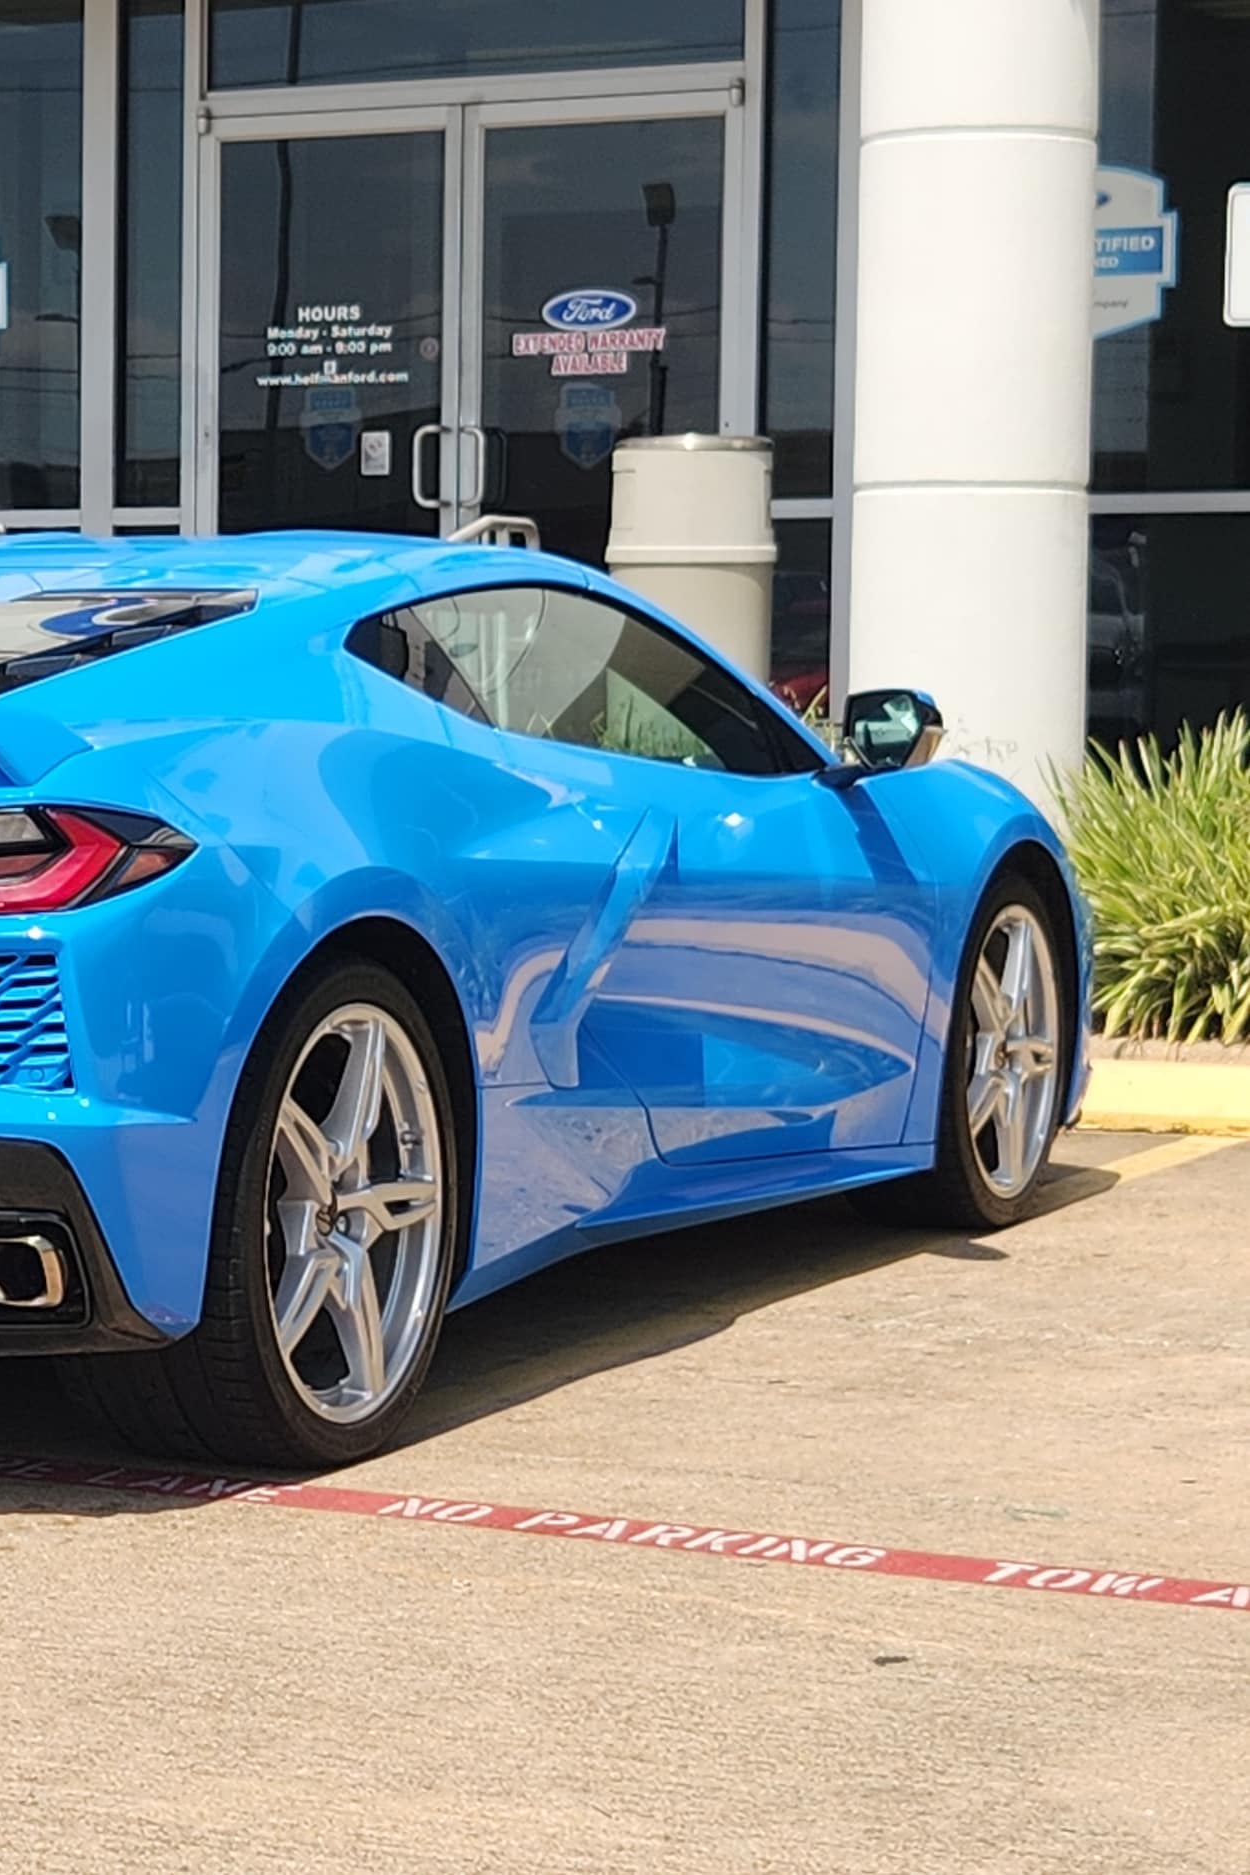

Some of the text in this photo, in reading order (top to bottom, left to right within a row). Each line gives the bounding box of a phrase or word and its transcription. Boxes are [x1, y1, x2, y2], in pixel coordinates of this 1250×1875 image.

[1093, 235, 1154, 252] TIFIED
[297, 305, 361, 322] HOURS
[561, 297, 617, 322] Ford
[267, 326, 319, 341] Monday
[330, 324, 392, 339] Saturday
[267, 342, 296, 356] 9:00
[301, 345, 323, 355] am
[370, 341, 393, 355] pm
[513, 328, 665, 355] EXTENDED WARRANTY
[551, 352, 627, 375] AVAILABLE
[256, 370, 410, 387] www.helfmanford.com
[85, 1467, 302, 1502] LANE
[377, 1496, 494, 1522] NO
[513, 1511, 886, 1567] PARKING
[981, 1561, 1164, 1596] TOW
